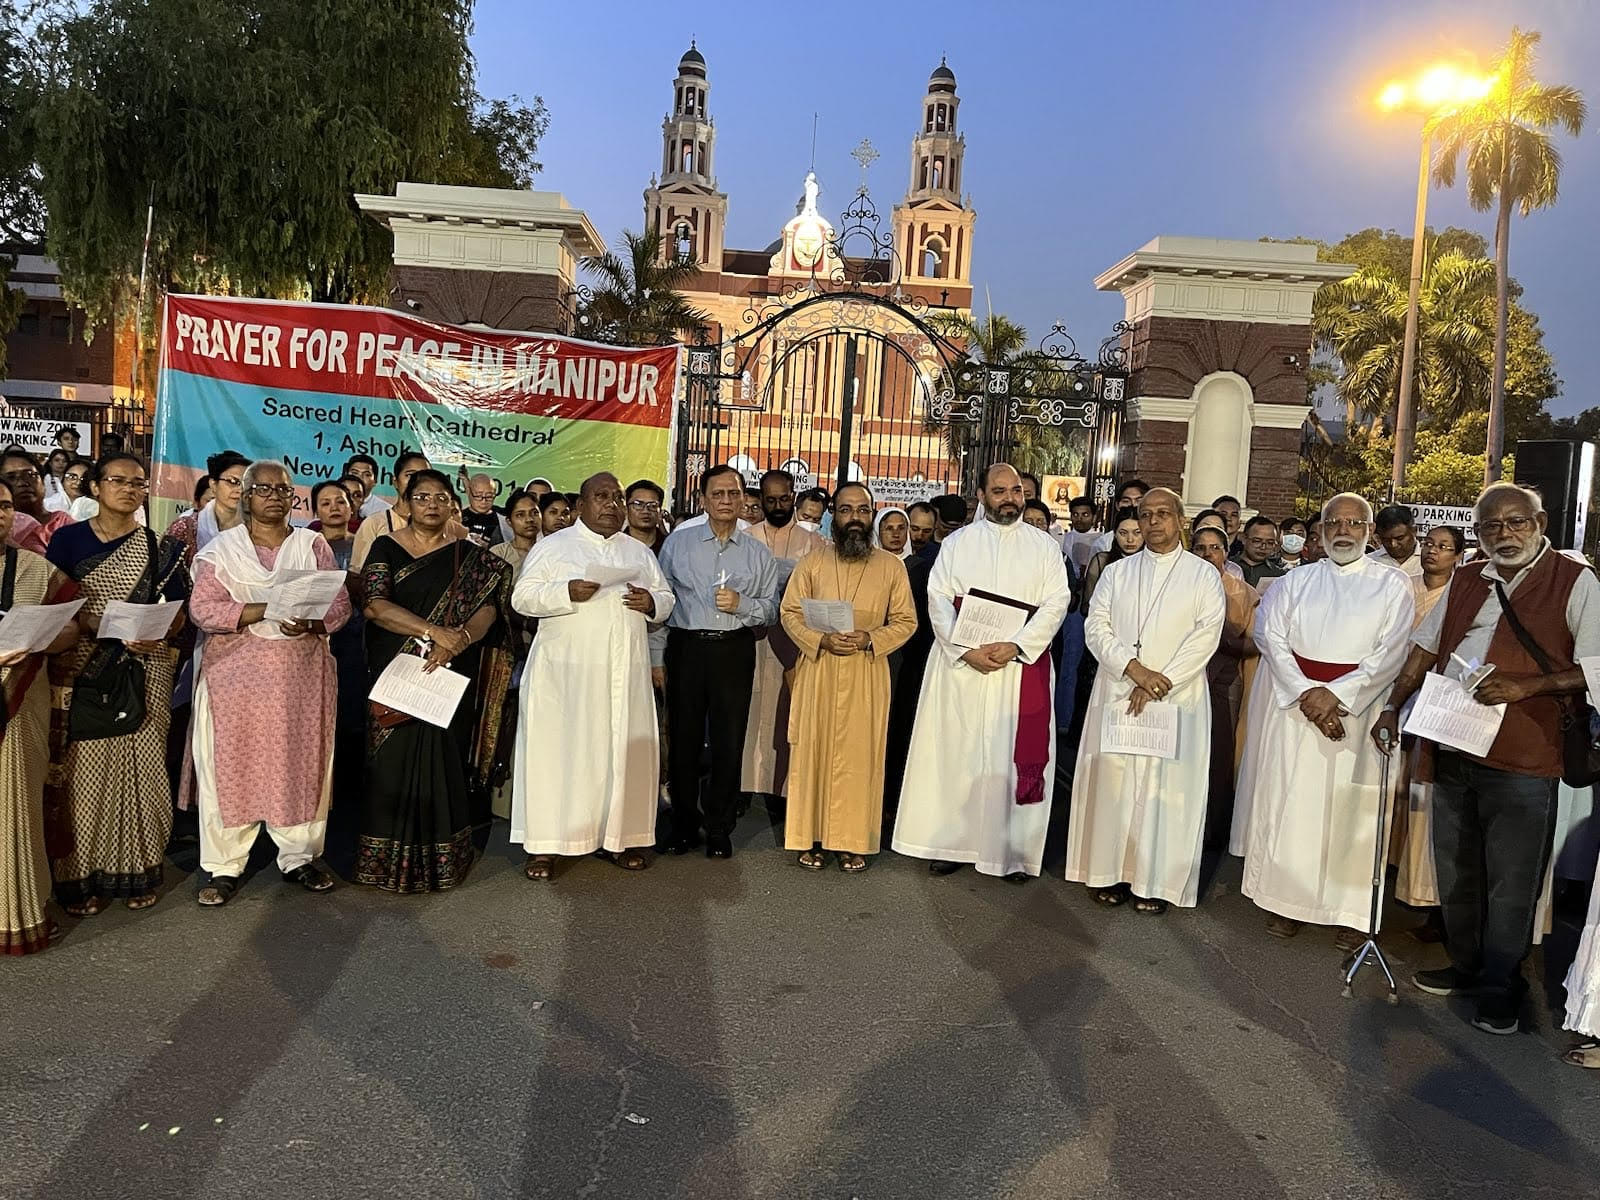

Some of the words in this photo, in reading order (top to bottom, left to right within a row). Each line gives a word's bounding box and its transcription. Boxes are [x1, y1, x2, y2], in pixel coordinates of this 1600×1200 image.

[175, 310, 281, 368] PRAYER
[289, 327, 348, 373] FOR
[356, 332, 461, 385] PEACE
[470, 345, 505, 387] IN
[513, 349, 660, 407] MANIPUR
[14, 421, 42, 432] AWAY
[262, 398, 342, 424] Sacred
[350, 406, 419, 430] Heart
[426, 414, 554, 445] Cathedral
[1, 434, 47, 446] PARKING
[313, 432, 332, 454] 1,
[340, 434, 412, 458] Ashok
[283, 455, 335, 479] New
[1423, 508, 1472, 522] PARKING
